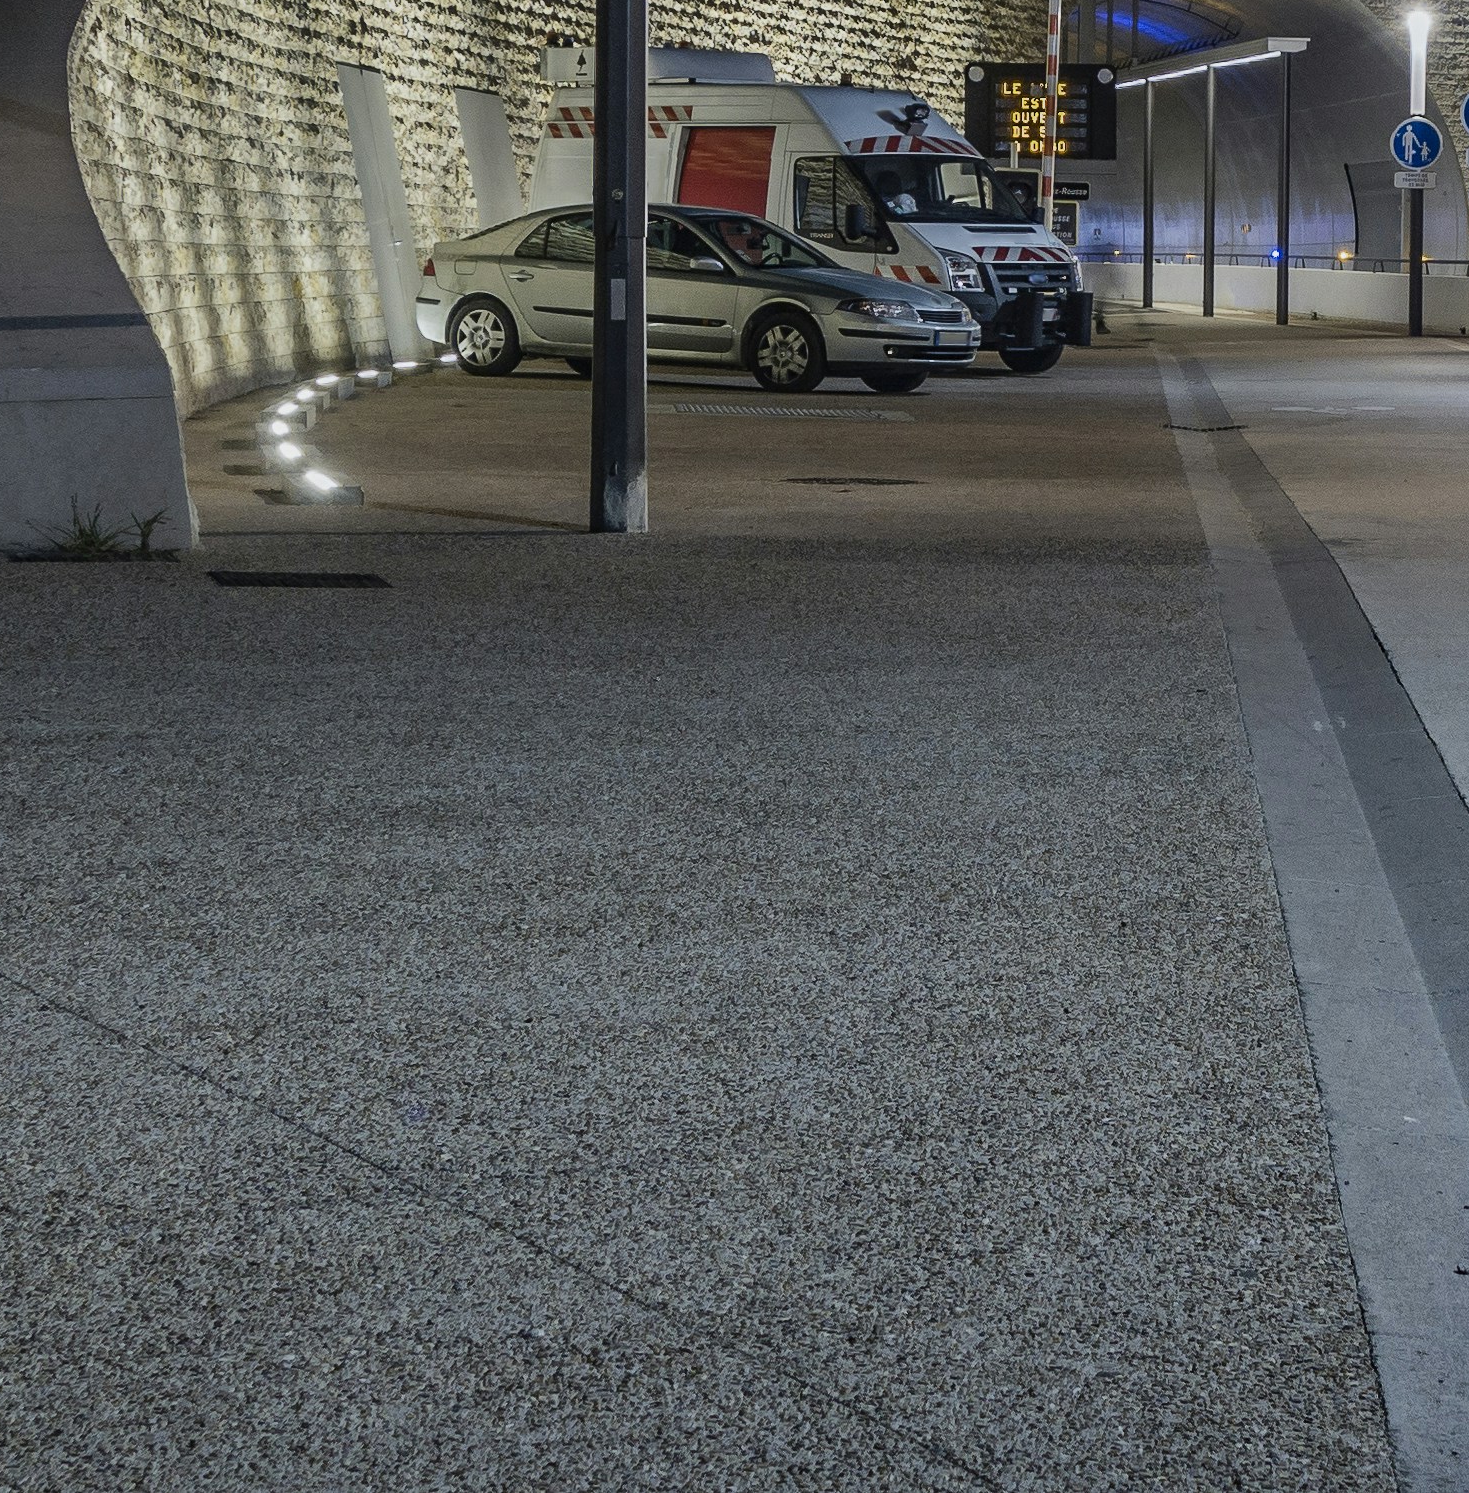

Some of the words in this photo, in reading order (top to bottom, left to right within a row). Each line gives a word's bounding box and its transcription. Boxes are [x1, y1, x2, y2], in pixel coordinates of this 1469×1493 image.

[1002, 82, 1022, 95] LE
[1012, 111, 1066, 124] OUVET
[1012, 125, 1030, 138] DE
